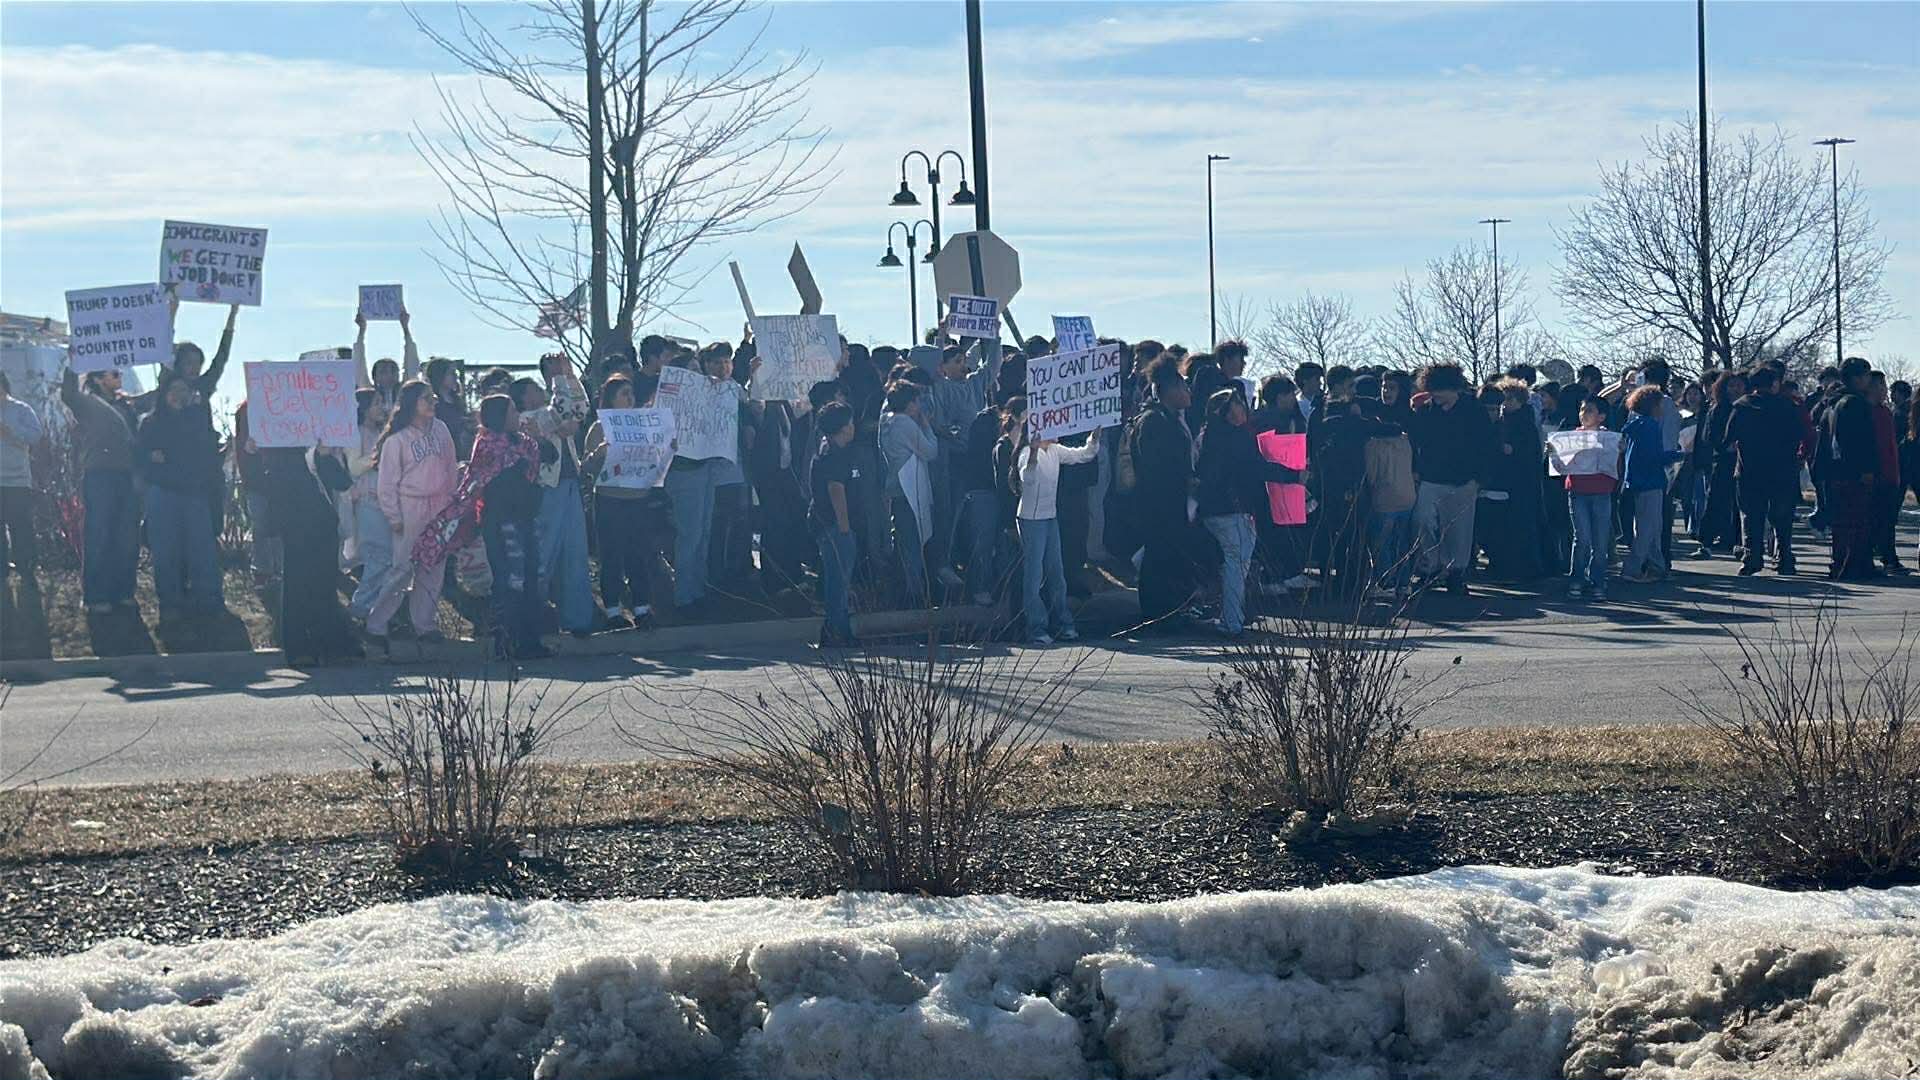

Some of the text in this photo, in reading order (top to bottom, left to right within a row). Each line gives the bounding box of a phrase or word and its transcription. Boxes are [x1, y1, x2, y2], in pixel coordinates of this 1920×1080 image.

[164, 226, 260, 247] IMMIGRANTS
[168, 248, 262, 271] WE GET THE
[177, 265, 207, 283] JOB
[68, 297, 108, 313] TRUMP
[74, 319, 133, 338] OWN THIS
[77, 336, 156, 356] COUNTRY OR
[1029, 366, 1052, 388] YOU
[1091, 349, 1120, 371] LOVE
[1028, 388, 1048, 409] THE
[1052, 379, 1098, 405] CULTURE
[1103, 372, 1121, 396] NOT
[608, 414, 661, 428] NO ONE IS
[1029, 405, 1072, 432] SUPPORT
[1074, 402, 1093, 421] THE
